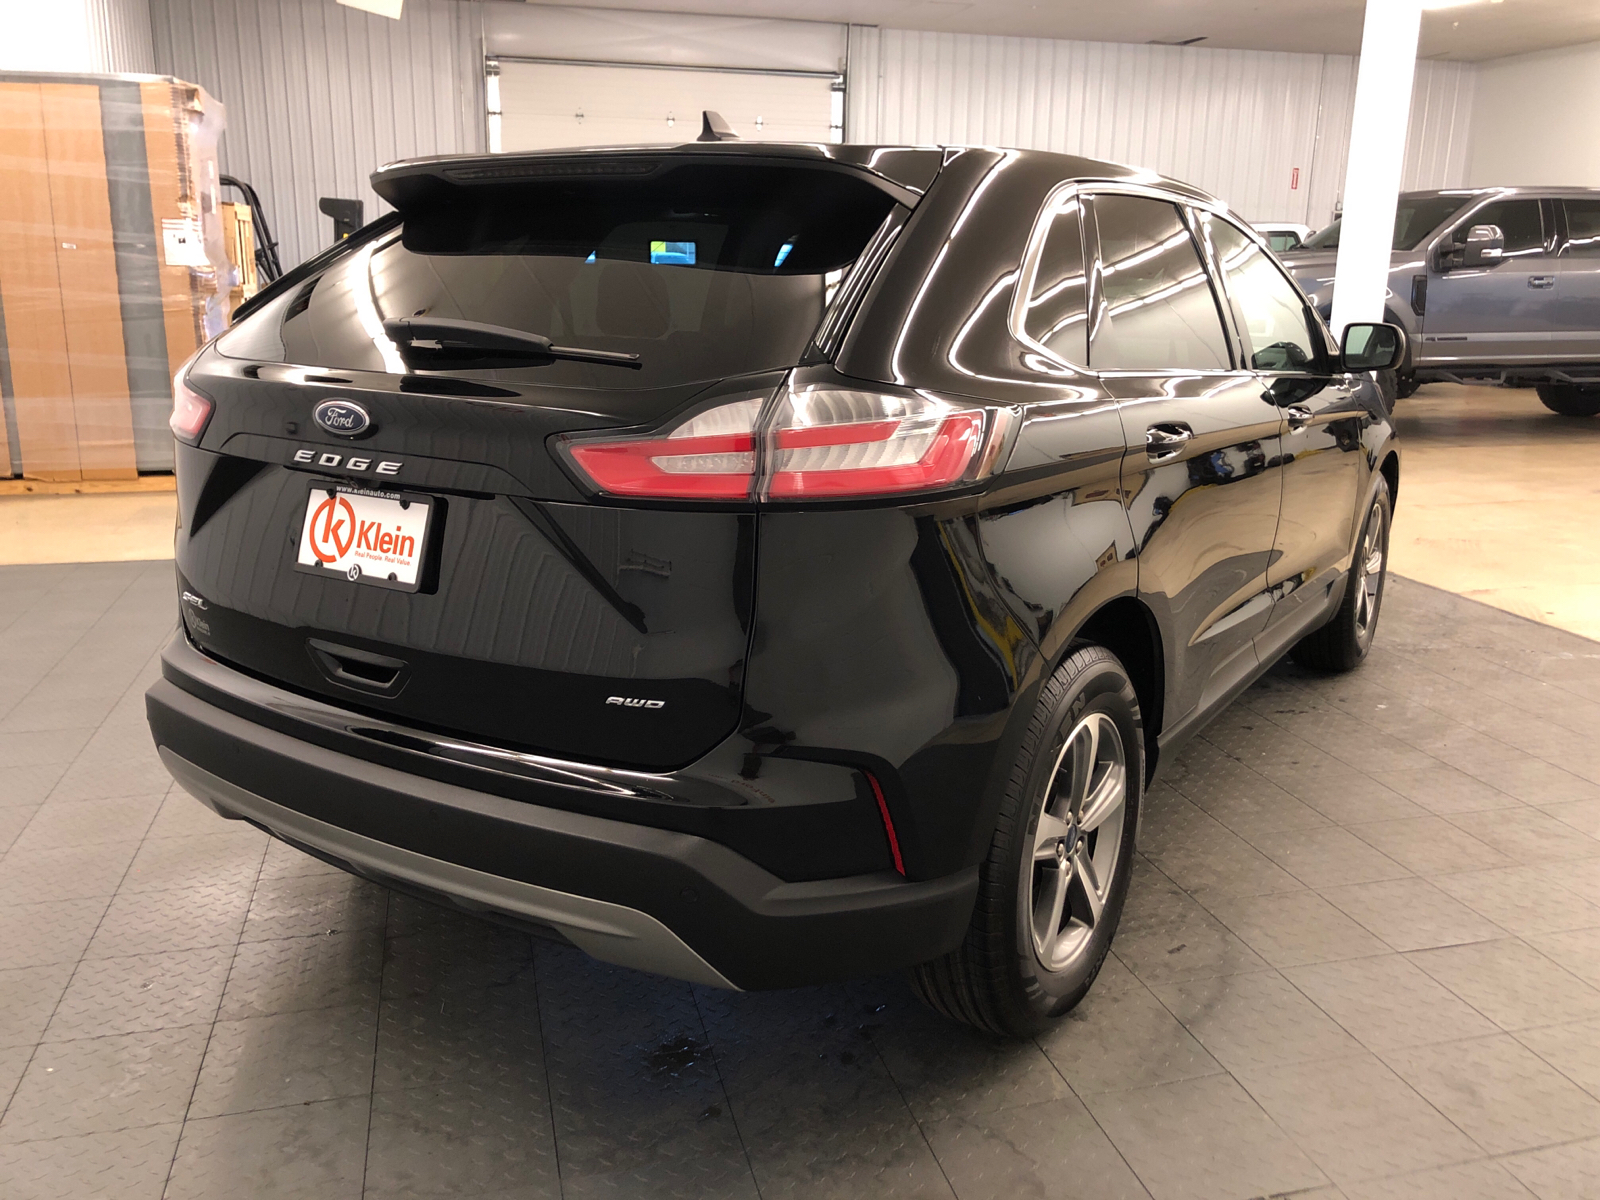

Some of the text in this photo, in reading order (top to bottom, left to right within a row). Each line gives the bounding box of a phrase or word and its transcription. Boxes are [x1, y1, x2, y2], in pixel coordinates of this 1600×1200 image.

[325, 407, 354, 428] Ford
[293, 449, 404, 475] EDGE
[336, 485, 401, 499] www.kleinauto.com
[356, 520, 415, 557] Klein
[354, 550, 365, 558] Real
[384, 555, 395, 564] Real
[183, 591, 208, 610] SEL
[605, 696, 666, 709] AWD
